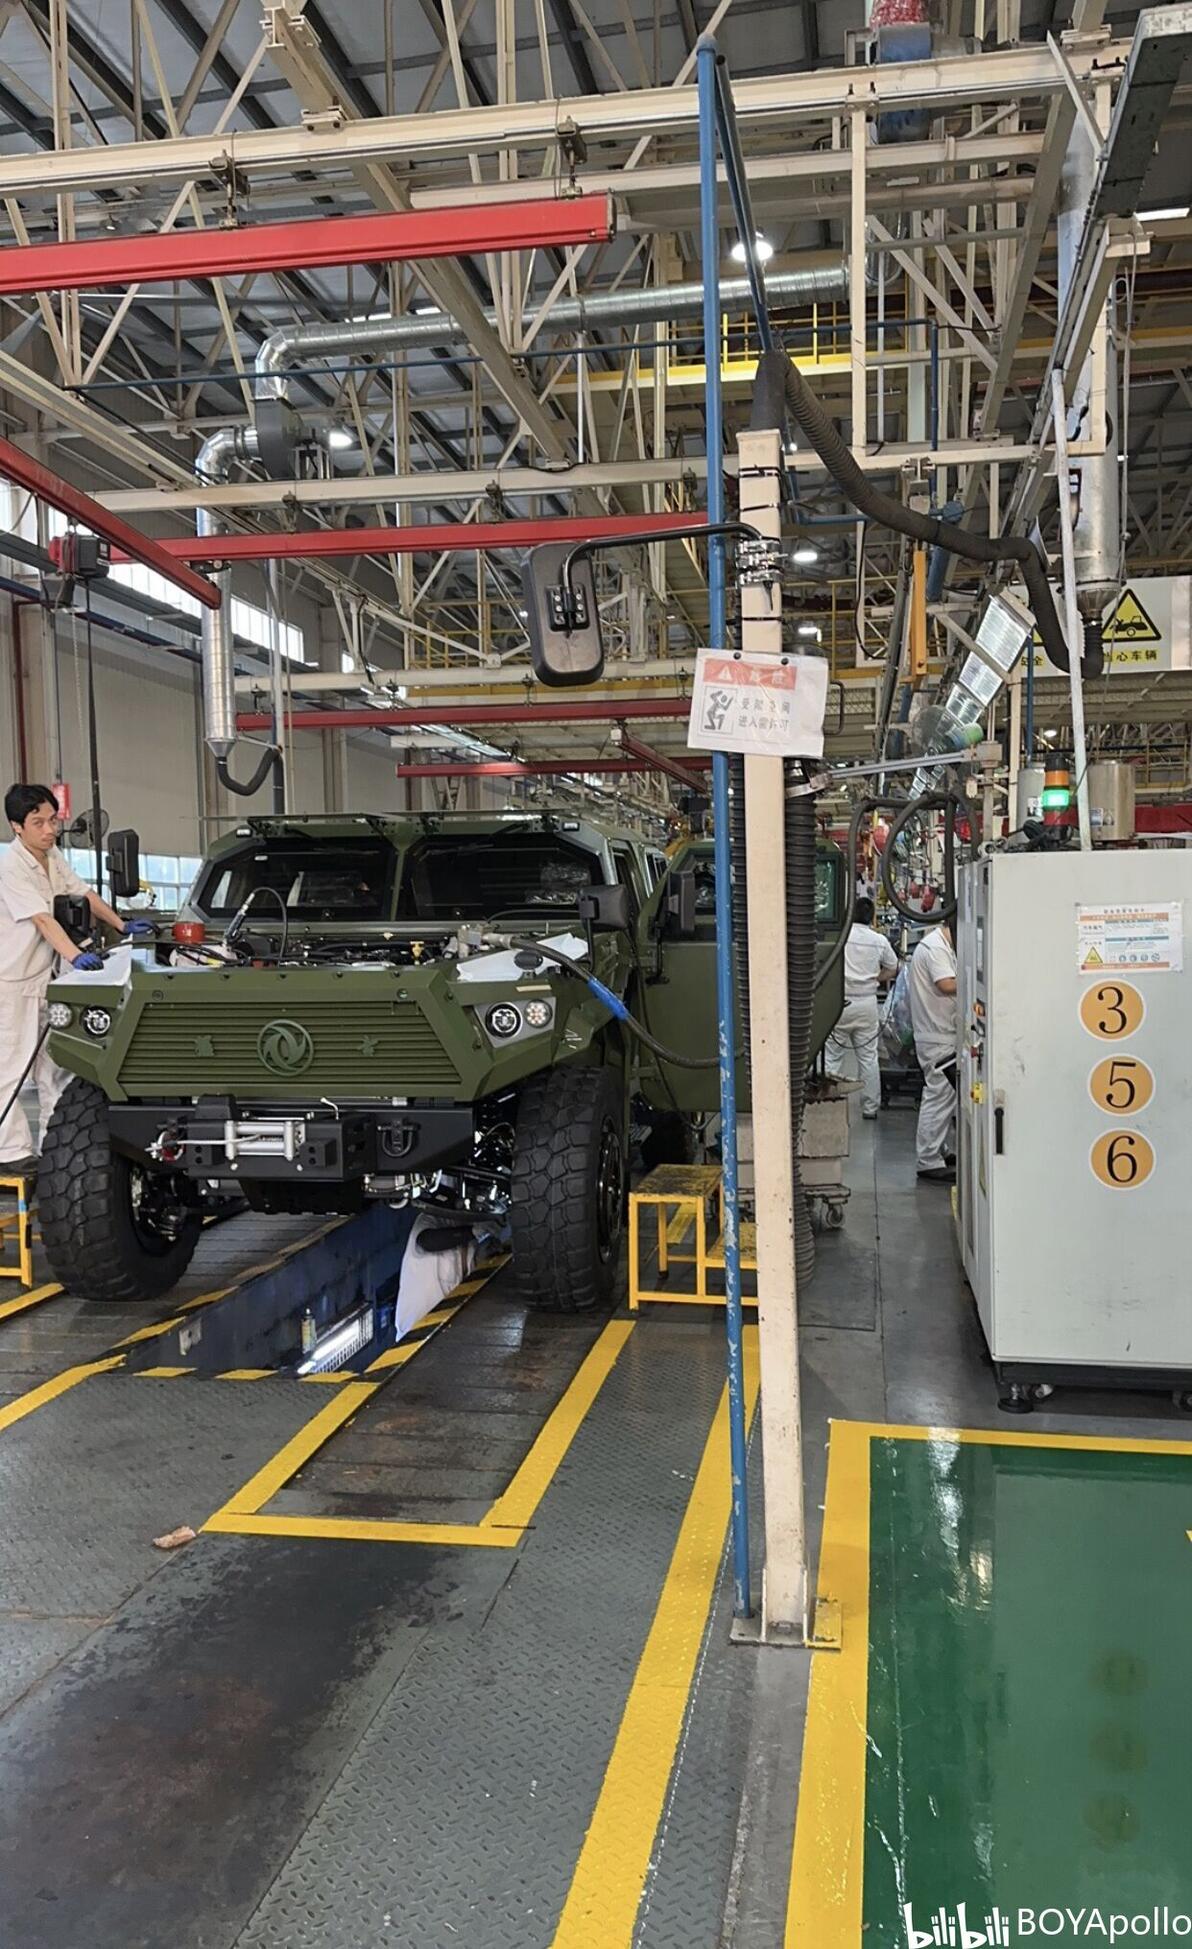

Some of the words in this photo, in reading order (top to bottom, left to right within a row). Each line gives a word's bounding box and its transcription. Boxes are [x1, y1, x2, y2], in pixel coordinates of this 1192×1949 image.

[1097, 986, 1127, 1034] 3
[1105, 1061, 1137, 1109] 5
[1107, 1135, 1138, 1183] 6
